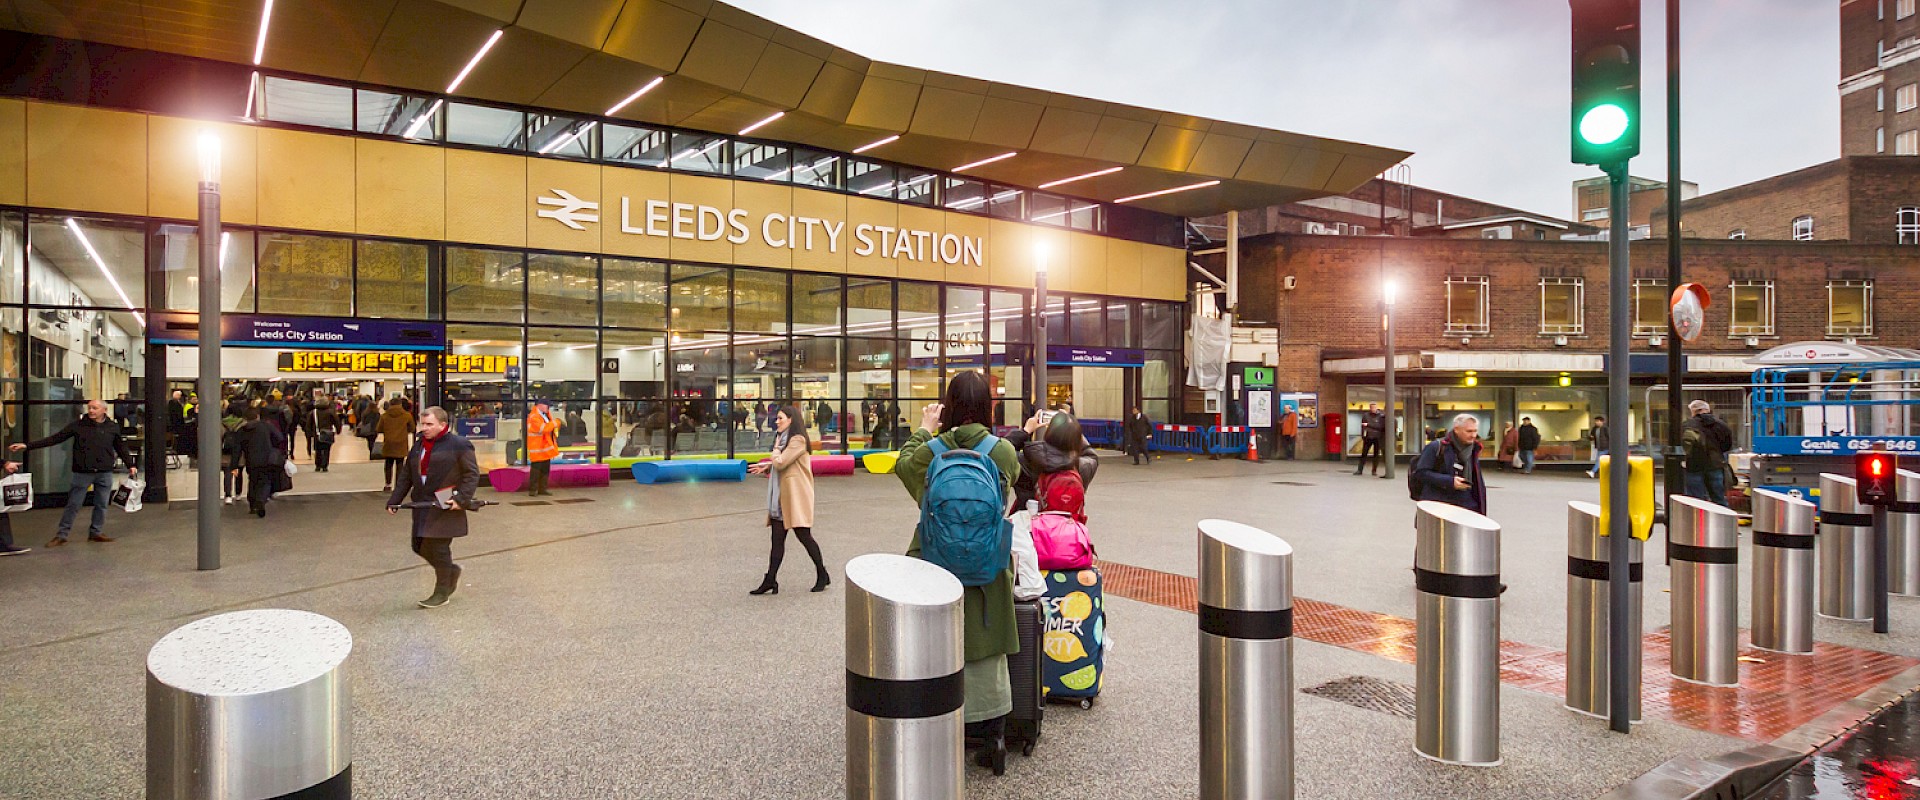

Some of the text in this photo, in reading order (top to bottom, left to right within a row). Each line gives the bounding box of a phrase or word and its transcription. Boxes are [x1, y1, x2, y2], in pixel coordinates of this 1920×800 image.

[621, 196, 983, 266] LEEDS CITY STATION
[253, 329, 344, 341] Leeds City Station
[1800, 439, 1917, 451] Genie GS-646
[6, 488, 27, 497] M&S
[1040, 596, 1073, 615] EST
[1046, 637, 1076, 656] RTY
